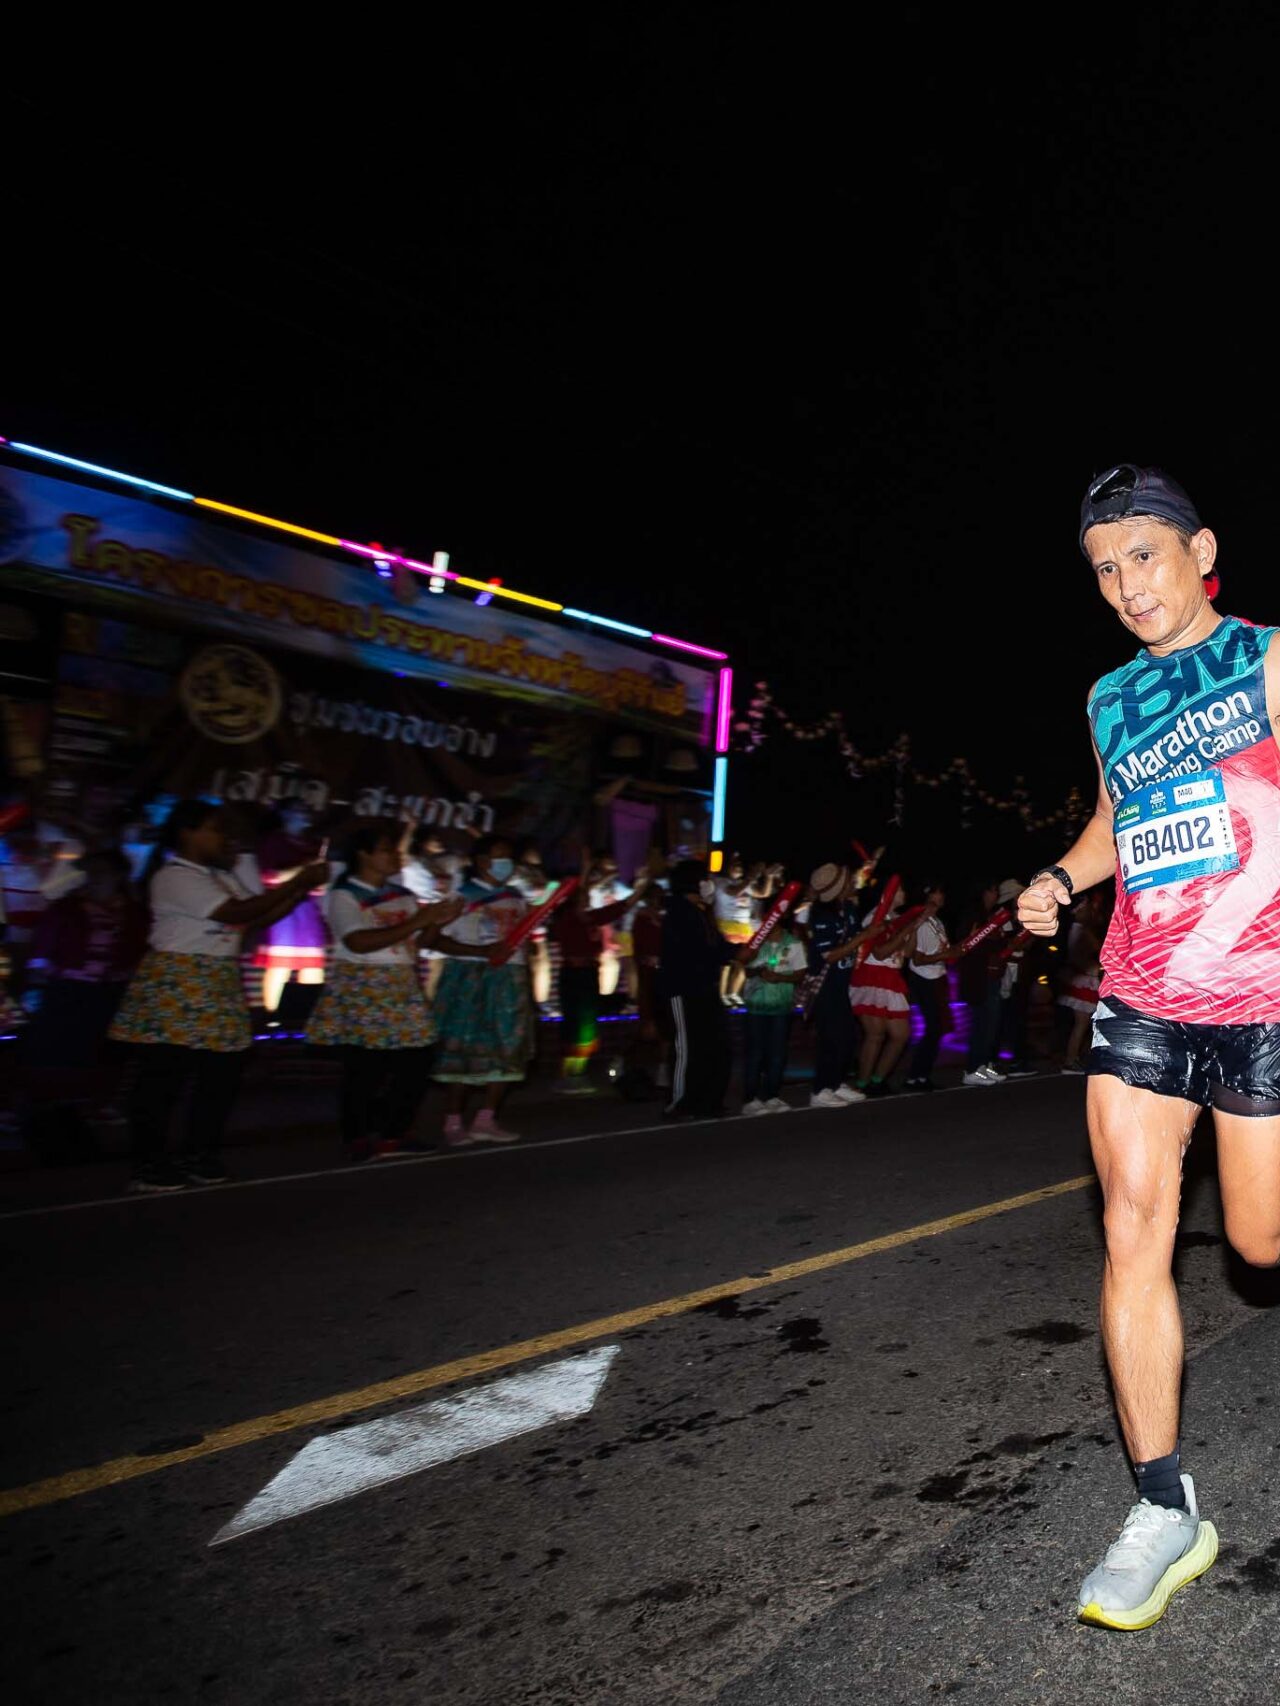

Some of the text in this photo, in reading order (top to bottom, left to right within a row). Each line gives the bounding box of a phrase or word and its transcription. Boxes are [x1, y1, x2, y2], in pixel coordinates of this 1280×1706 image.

[1114, 690, 1253, 791] Marathon
[1198, 717, 1261, 763] Camp
[1131, 815, 1214, 866] 68402
